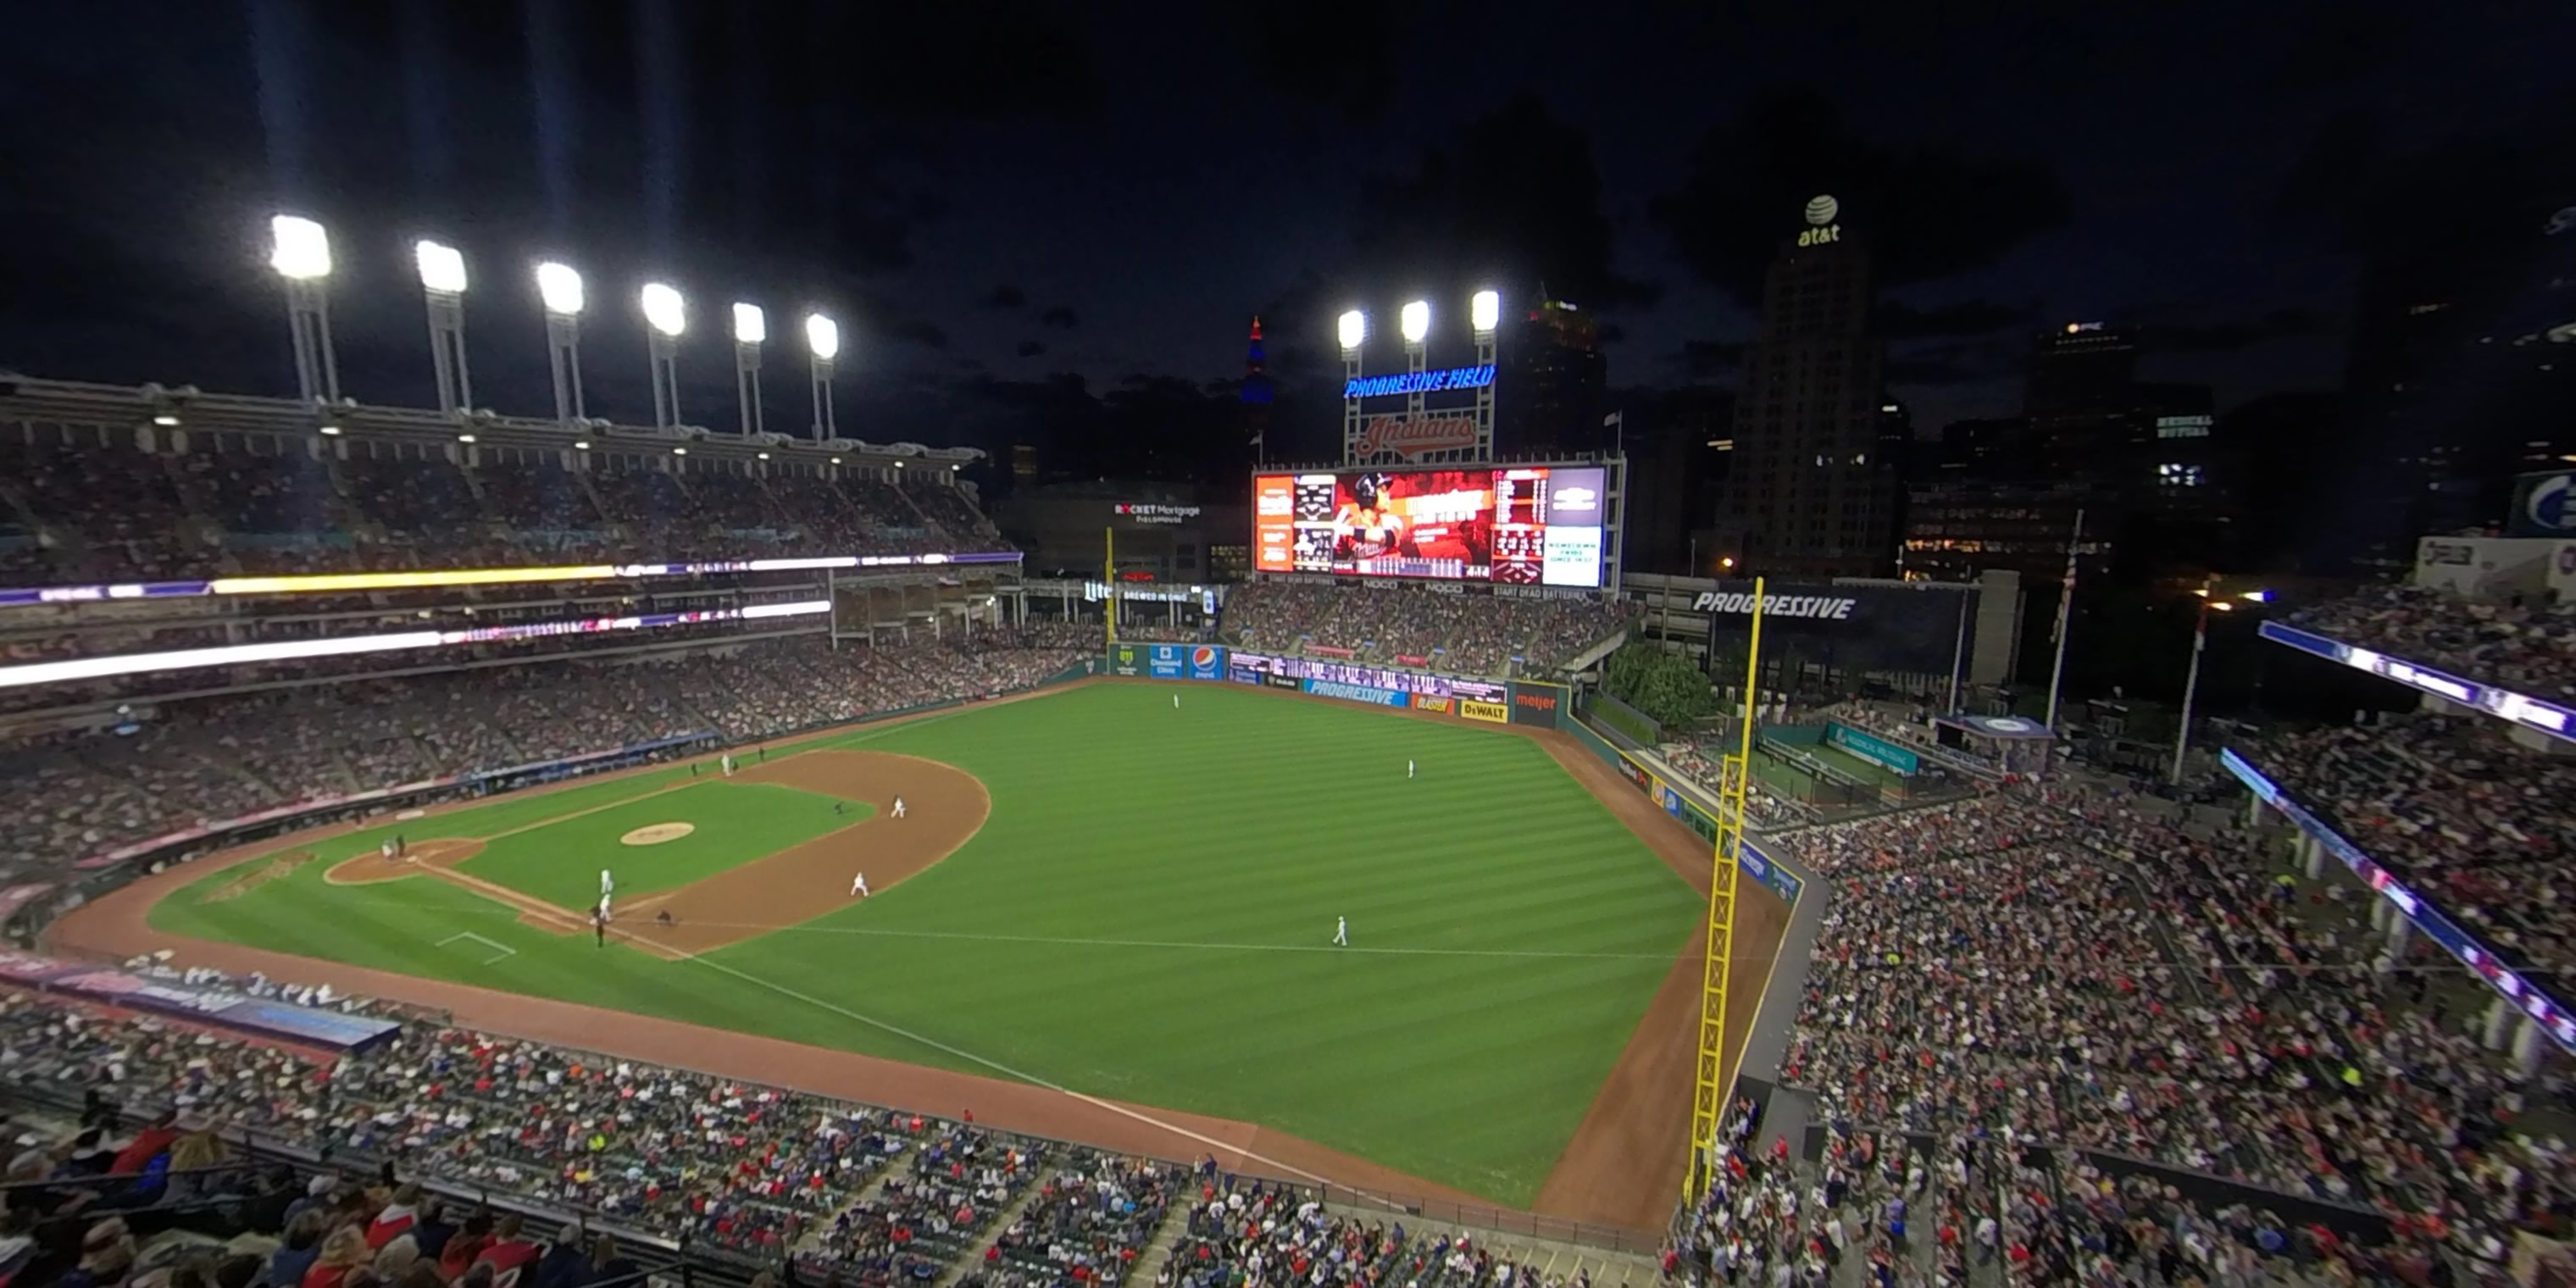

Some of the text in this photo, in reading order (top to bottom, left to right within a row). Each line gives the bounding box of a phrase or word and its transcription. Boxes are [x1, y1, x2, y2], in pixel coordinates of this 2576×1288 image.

[1798, 224, 1840, 247] at&t
[1344, 365, 1496, 398] PROGRESSIVE FIELD
[1356, 413, 1476, 457] Indians
[1115, 503, 1200, 516] ROCKET Mortgage
[1363, 579, 1398, 590] NOCO
[1425, 582, 1464, 594] NOCO
[1692, 591, 1856, 619] PROGRESSIVE
[1310, 680, 1396, 705] PROGRESSIVE
[1517, 694, 1557, 711] meijer
